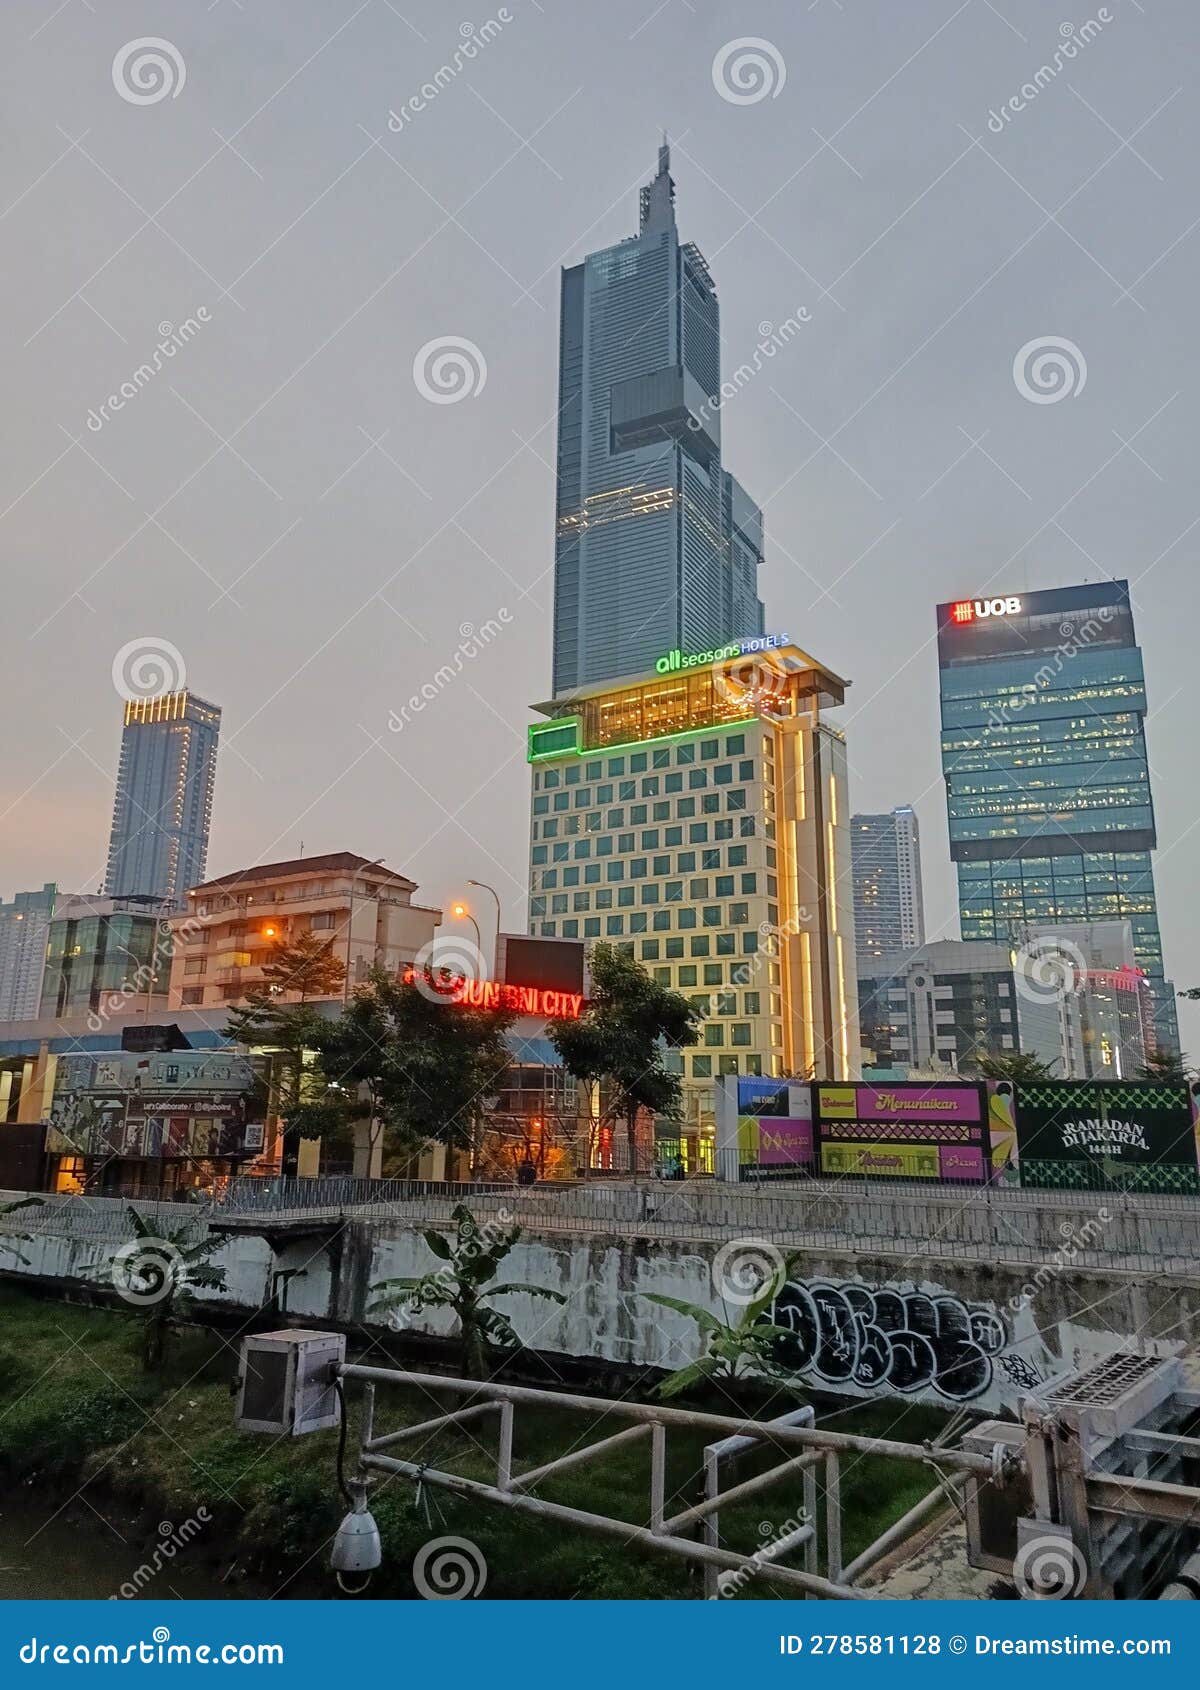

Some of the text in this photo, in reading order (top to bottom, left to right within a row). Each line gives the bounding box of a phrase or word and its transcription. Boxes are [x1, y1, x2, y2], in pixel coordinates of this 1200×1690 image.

[974, 597, 1022, 618] UOB
[741, 632, 790, 654] HOTELS
[543, 990, 582, 1018] CITY
[875, 1093, 958, 1112] Menunaikan
[1063, 1119, 1145, 1136] RAMADAN
[1061, 1130, 1150, 1151] DI JAKARTA
[1088, 1145, 1122, 1154] 1444H
